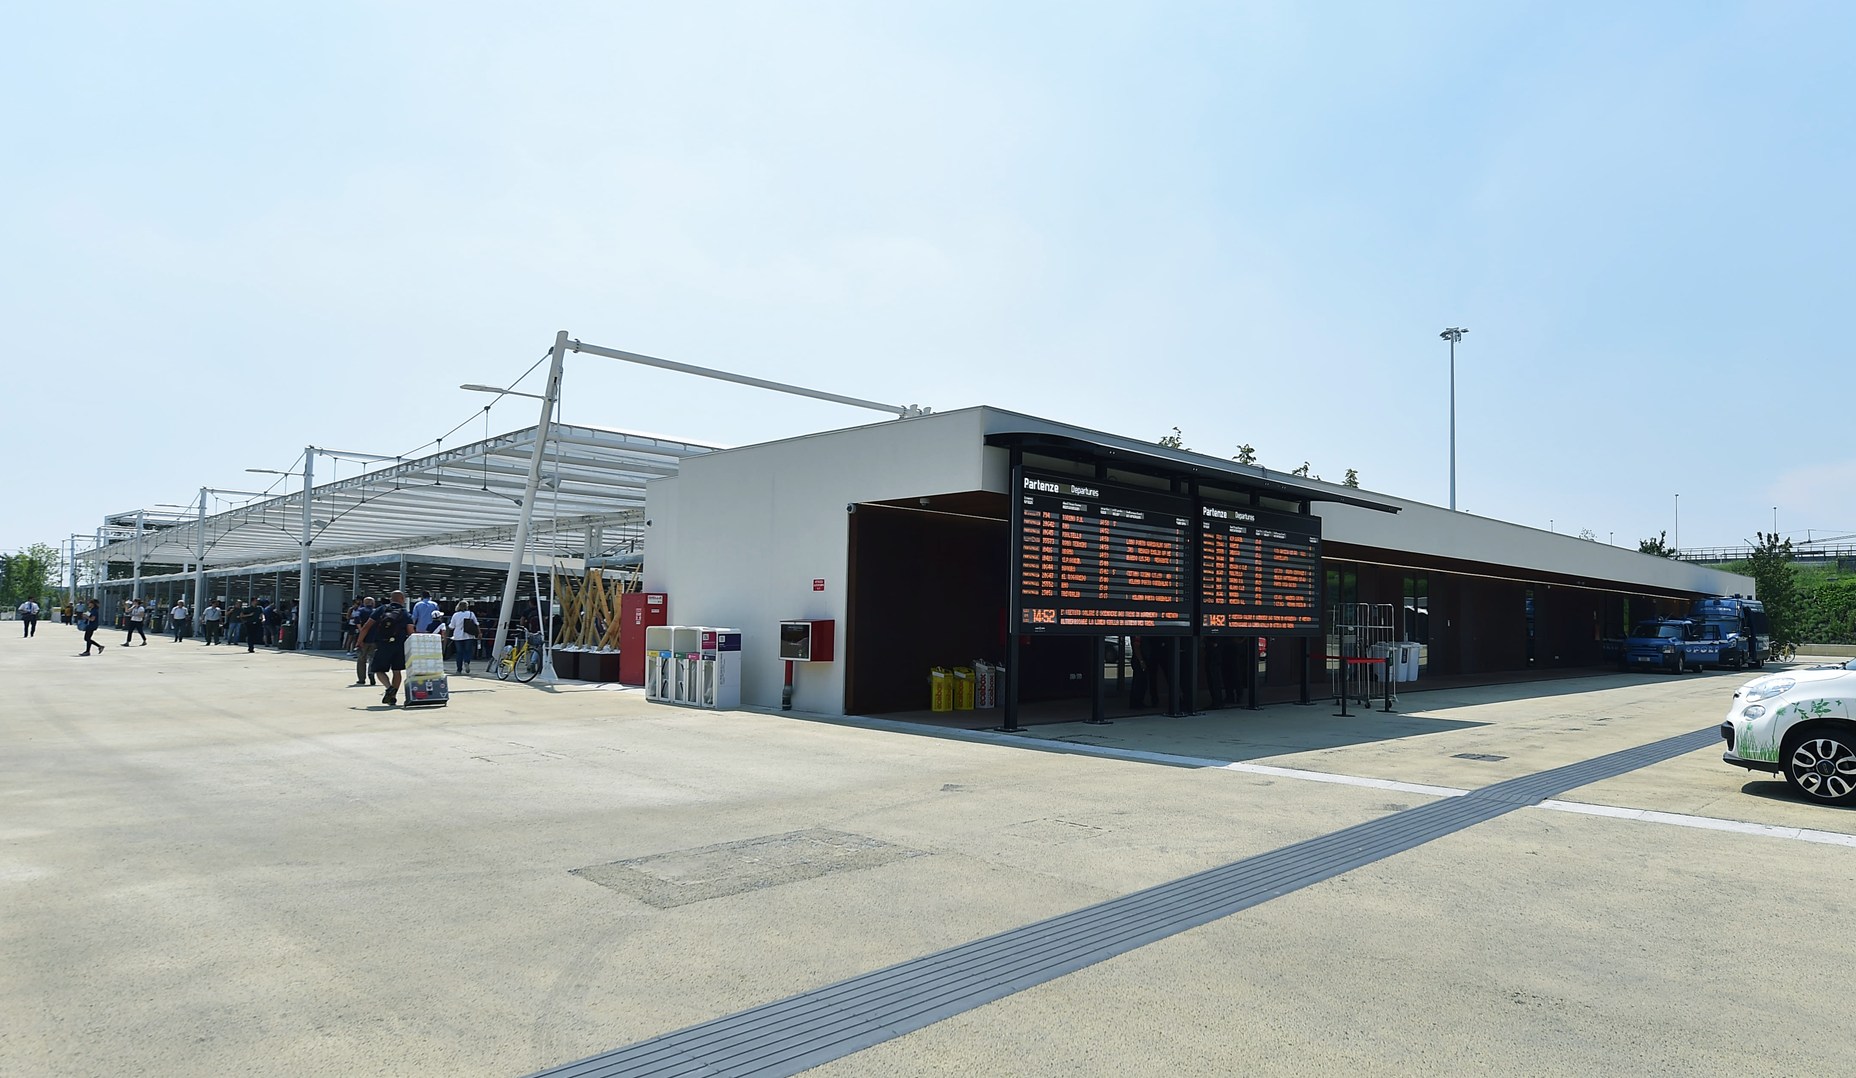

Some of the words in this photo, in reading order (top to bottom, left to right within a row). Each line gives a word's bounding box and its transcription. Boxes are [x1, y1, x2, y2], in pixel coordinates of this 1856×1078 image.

[1024, 477, 1059, 493] Partenze
[1070, 484, 1099, 497] Departures
[1202, 506, 1228, 518] Partenze
[1235, 512, 1255, 521] Departures
[1032, 609, 1055, 623] 14:52
[1210, 614, 1225, 626] 14:52
